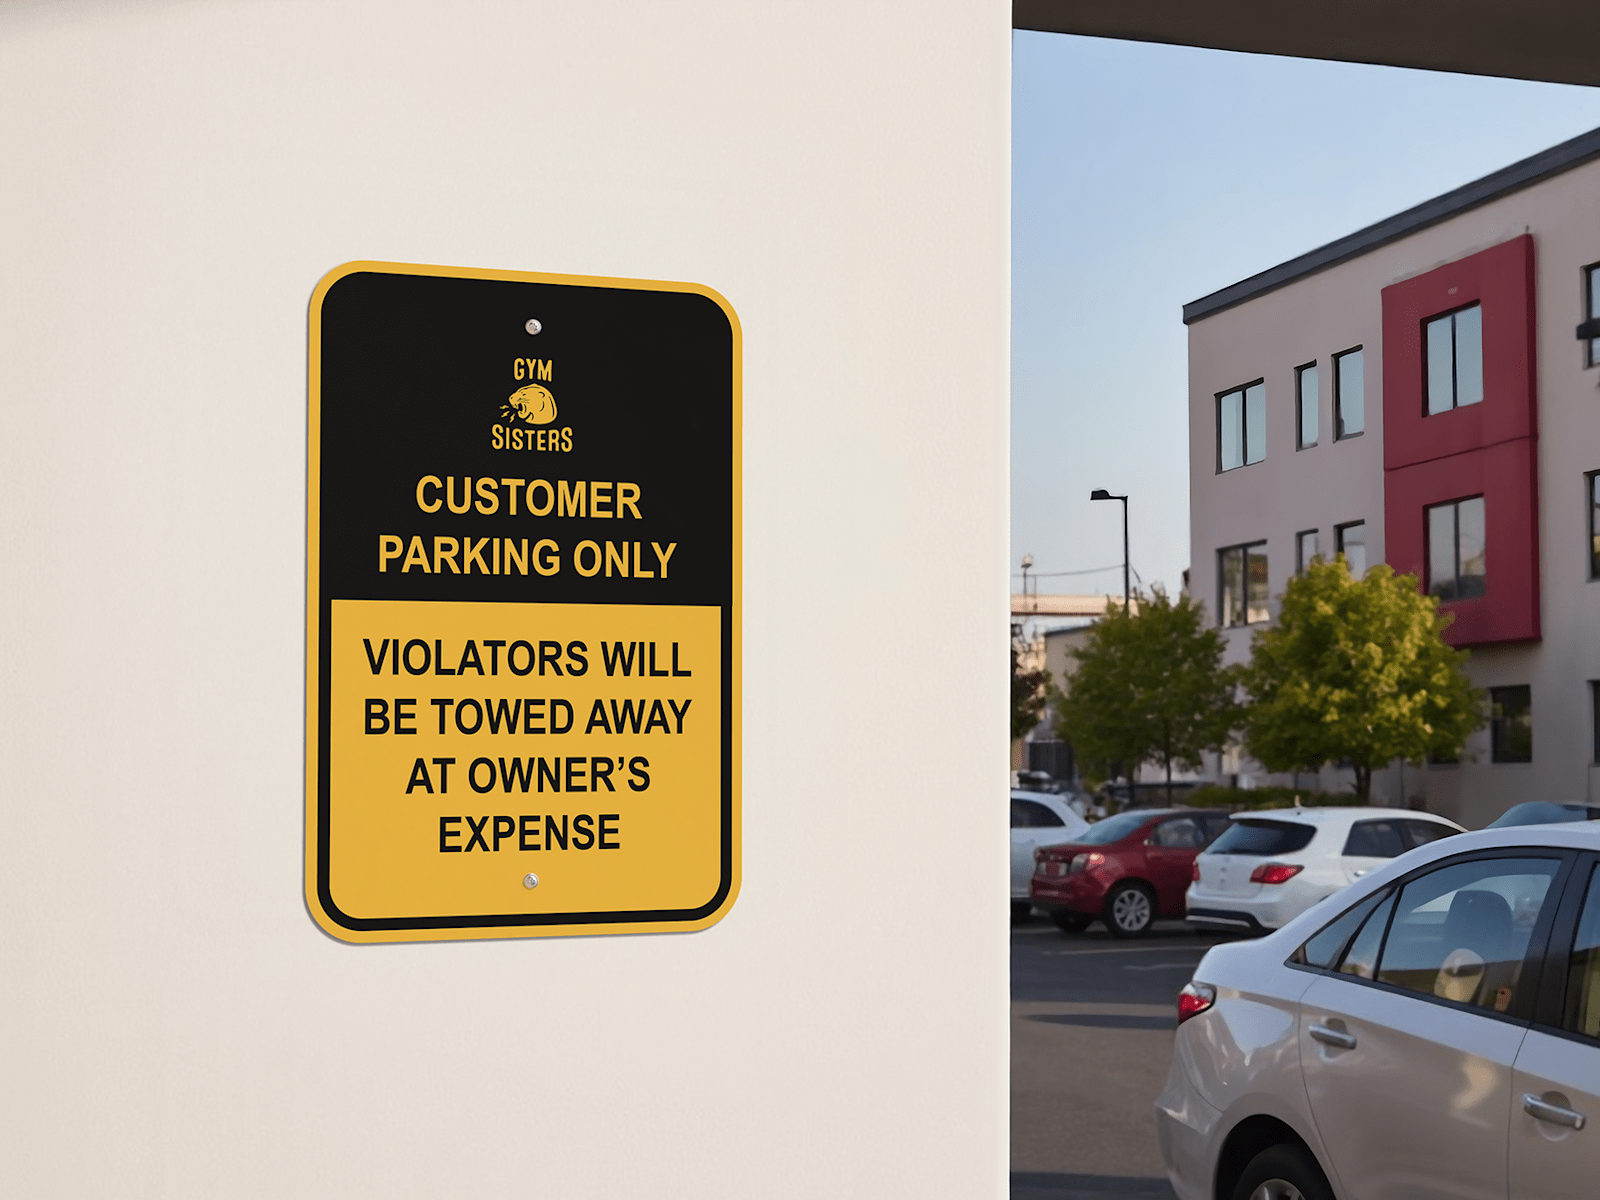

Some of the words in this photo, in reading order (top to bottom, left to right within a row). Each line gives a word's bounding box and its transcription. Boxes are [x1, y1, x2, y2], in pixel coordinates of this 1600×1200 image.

[514, 358, 552, 382] GYM
[492, 424, 572, 452] SISTERS
[417, 475, 642, 519] CUSTOMER
[380, 535, 559, 576] PARKING
[574, 540, 677, 578] ONLY
[363, 639, 588, 676] VIOLATORS
[601, 642, 691, 677] WILL
[365, 699, 417, 734] BE
[431, 699, 573, 734] TOWED
[585, 699, 692, 734] AWAY
[406, 758, 455, 794] AT
[469, 757, 650, 793] OWNER’S
[440, 814, 620, 852] EXPENSE
